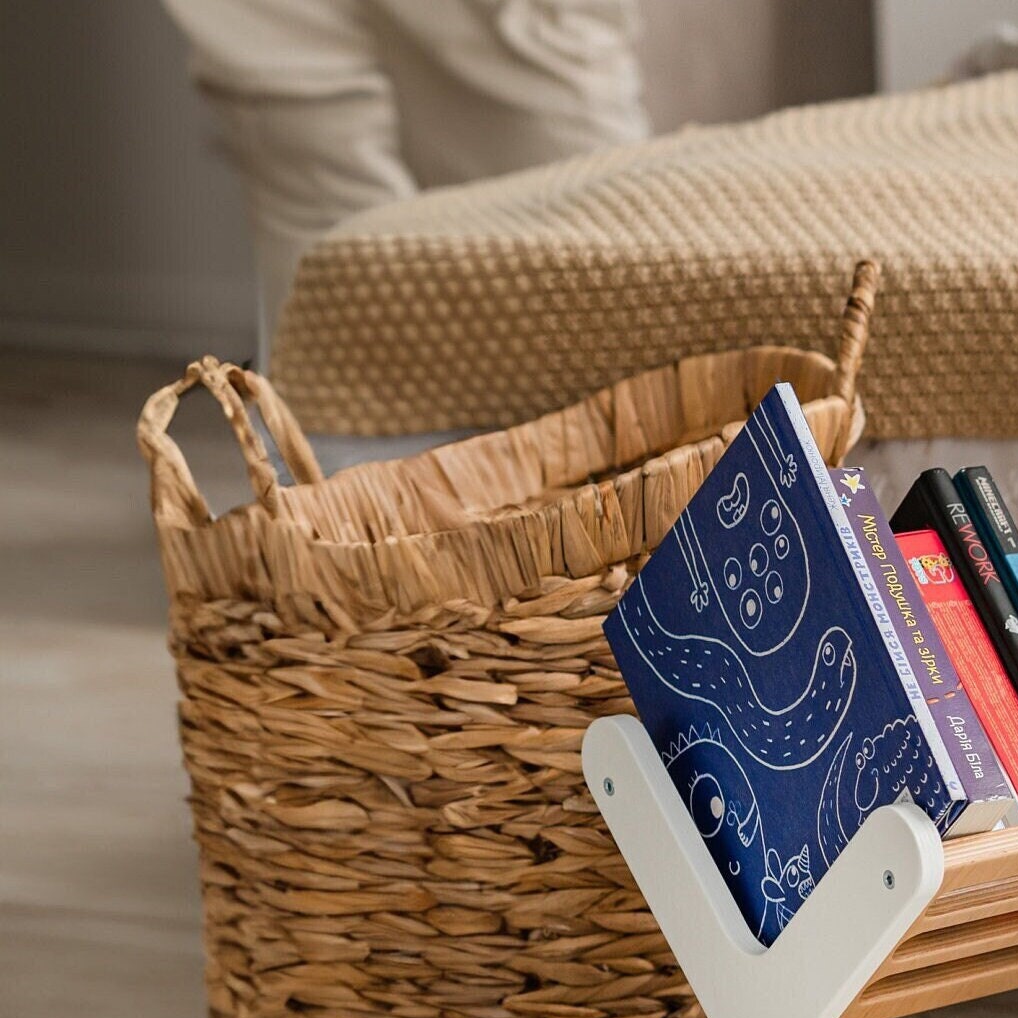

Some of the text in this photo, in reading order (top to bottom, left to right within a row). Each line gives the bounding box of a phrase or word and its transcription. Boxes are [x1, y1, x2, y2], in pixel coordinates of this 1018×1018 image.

[840, 526, 889, 624] МОНСТРИКІВ
[946, 503, 1000, 585] REWORK
[857, 514, 943, 684] Містер Подушка та зірки
[906, 682, 921, 700] НЕ
[946, 716, 984, 779] Дарія Біла
